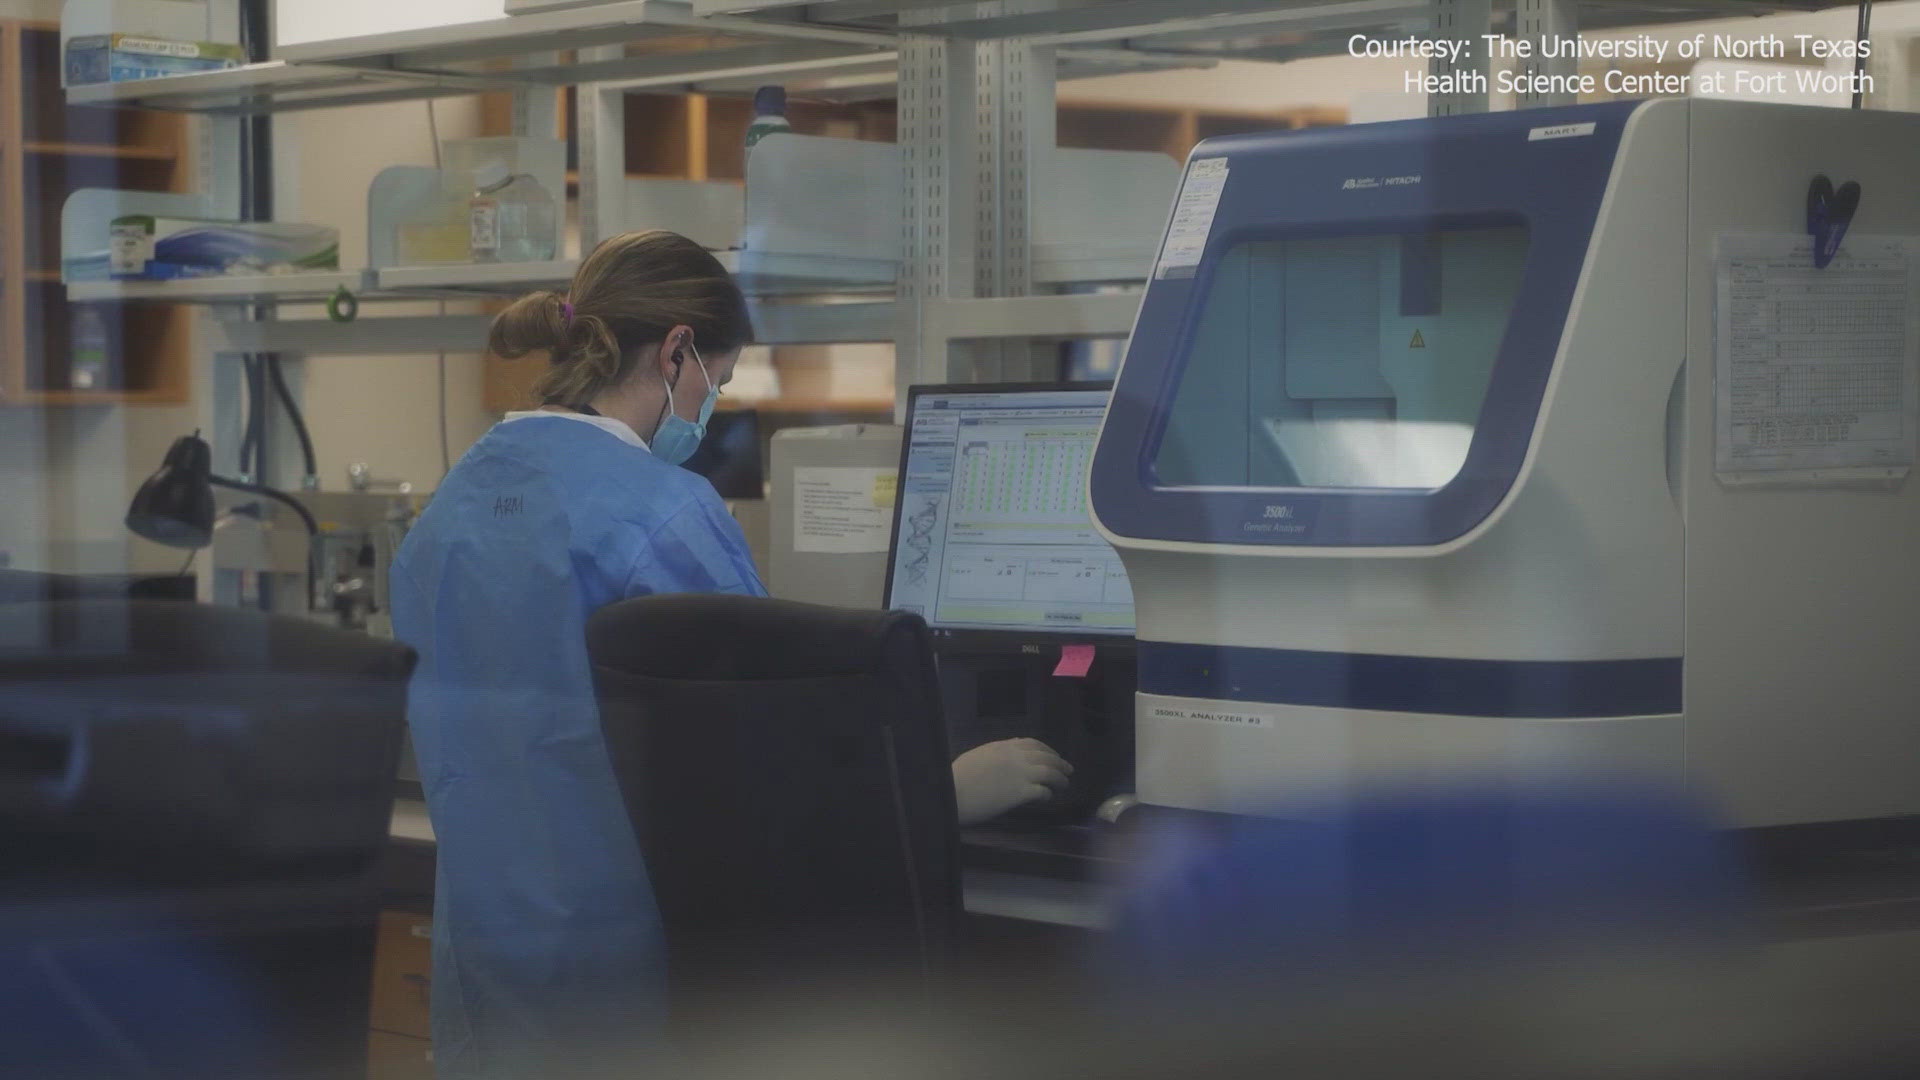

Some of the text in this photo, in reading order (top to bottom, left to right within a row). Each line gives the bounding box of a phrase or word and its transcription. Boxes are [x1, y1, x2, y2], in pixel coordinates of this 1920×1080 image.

[1543, 126, 1579, 137] MARY
[1384, 175, 1422, 186] HITACHI
[1021, 643, 1040, 655] DELL
[1154, 708, 1186, 718] 3500XL
[1190, 711, 1243, 723] ANALYZER
